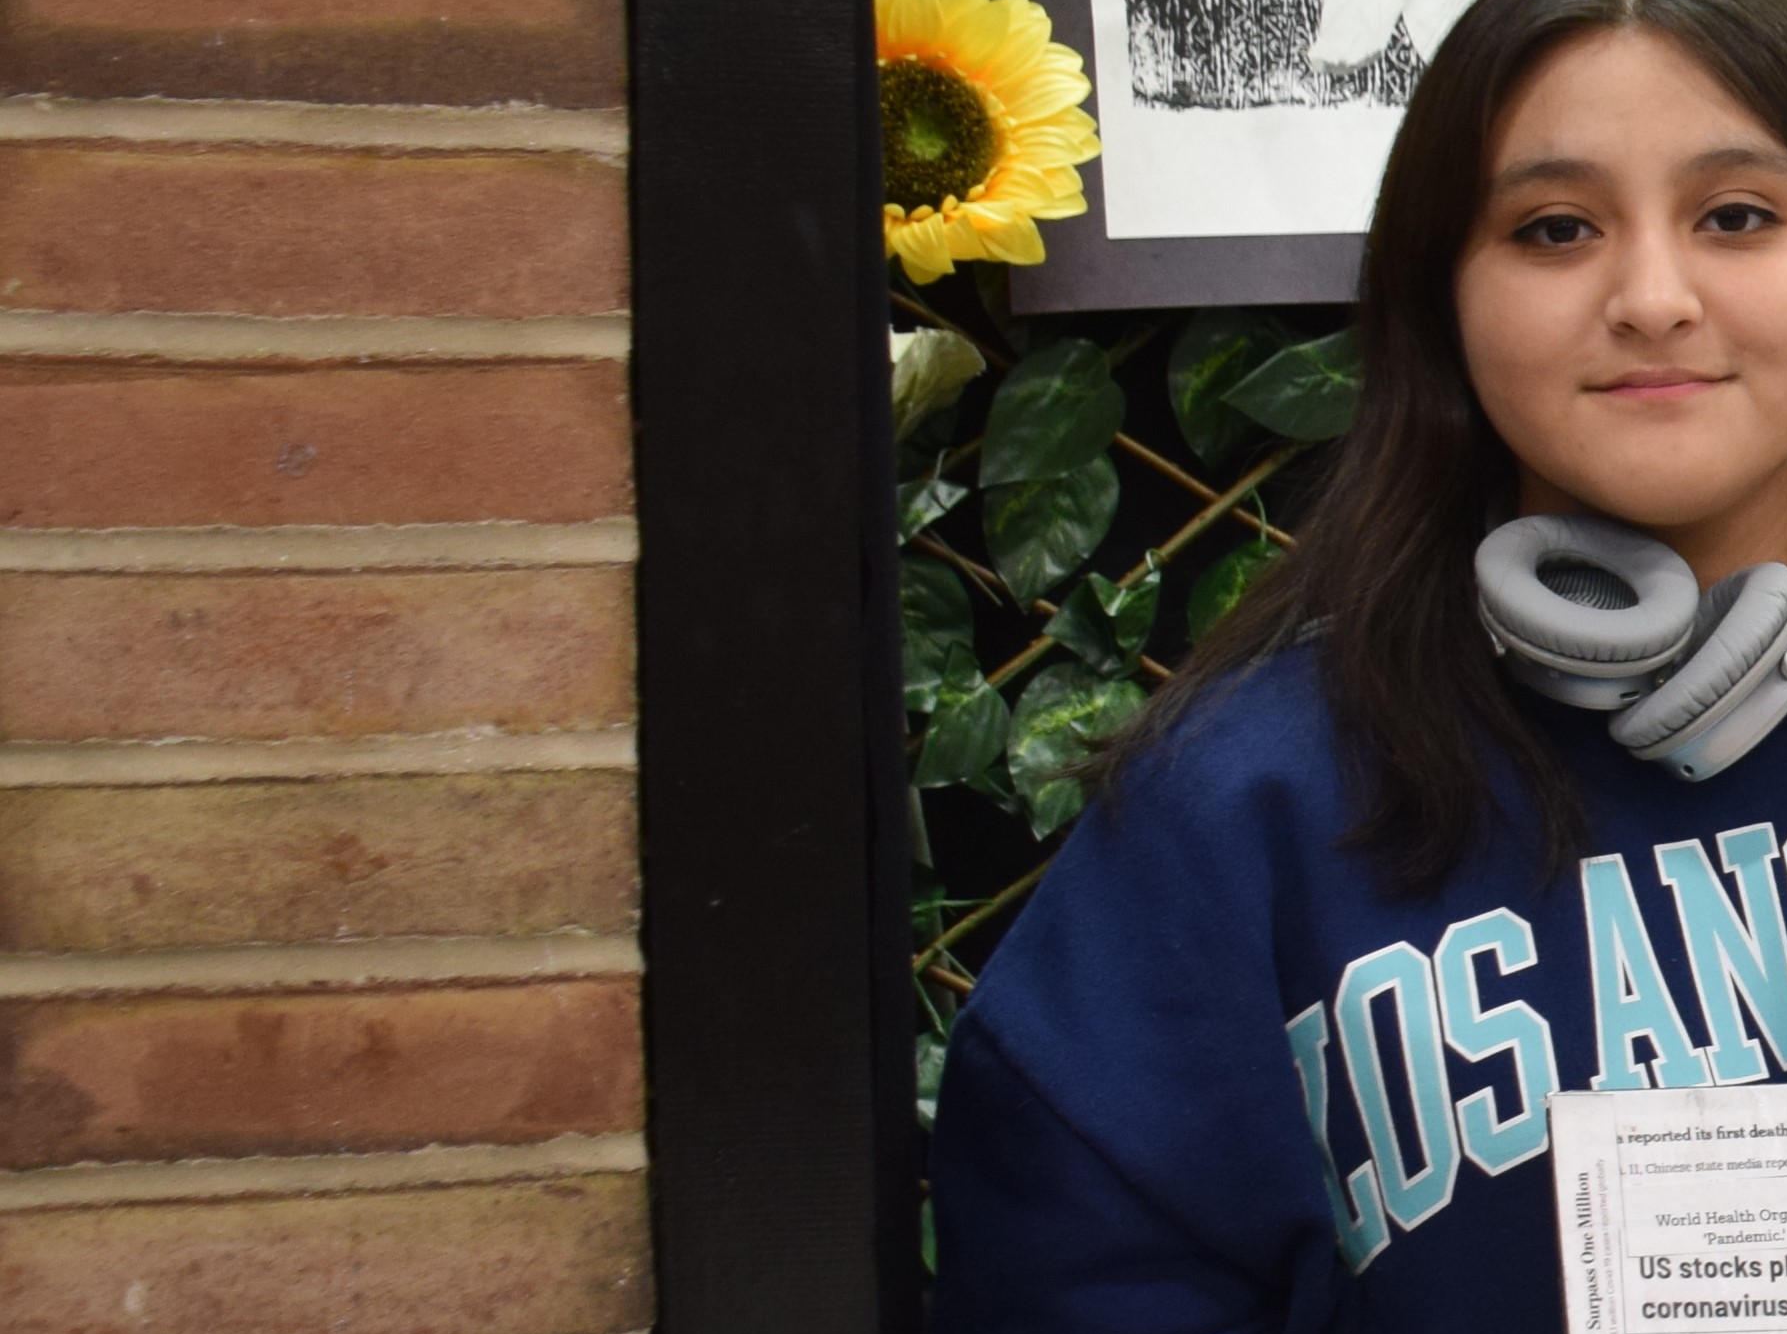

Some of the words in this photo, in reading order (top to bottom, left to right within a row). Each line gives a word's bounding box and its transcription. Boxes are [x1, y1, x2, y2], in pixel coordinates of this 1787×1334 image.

[1628, 1126, 1692, 1146] reported
[1695, 1125, 1713, 1140] its
[1716, 1124, 1746, 1139] first
[1645, 1161, 1693, 1175] Chinese
[1695, 1160, 1724, 1173] state
[1726, 1157, 1763, 1171] media
[1575, 1171, 1593, 1229] Million
[1655, 1212, 1702, 1228] World
[1705, 1210, 1757, 1226] Health
[1579, 1232, 1596, 1265] One
[1639, 1256, 1673, 1280] US
[1679, 1255, 1763, 1280] stocks
[1585, 1267, 1604, 1331] Surpass
